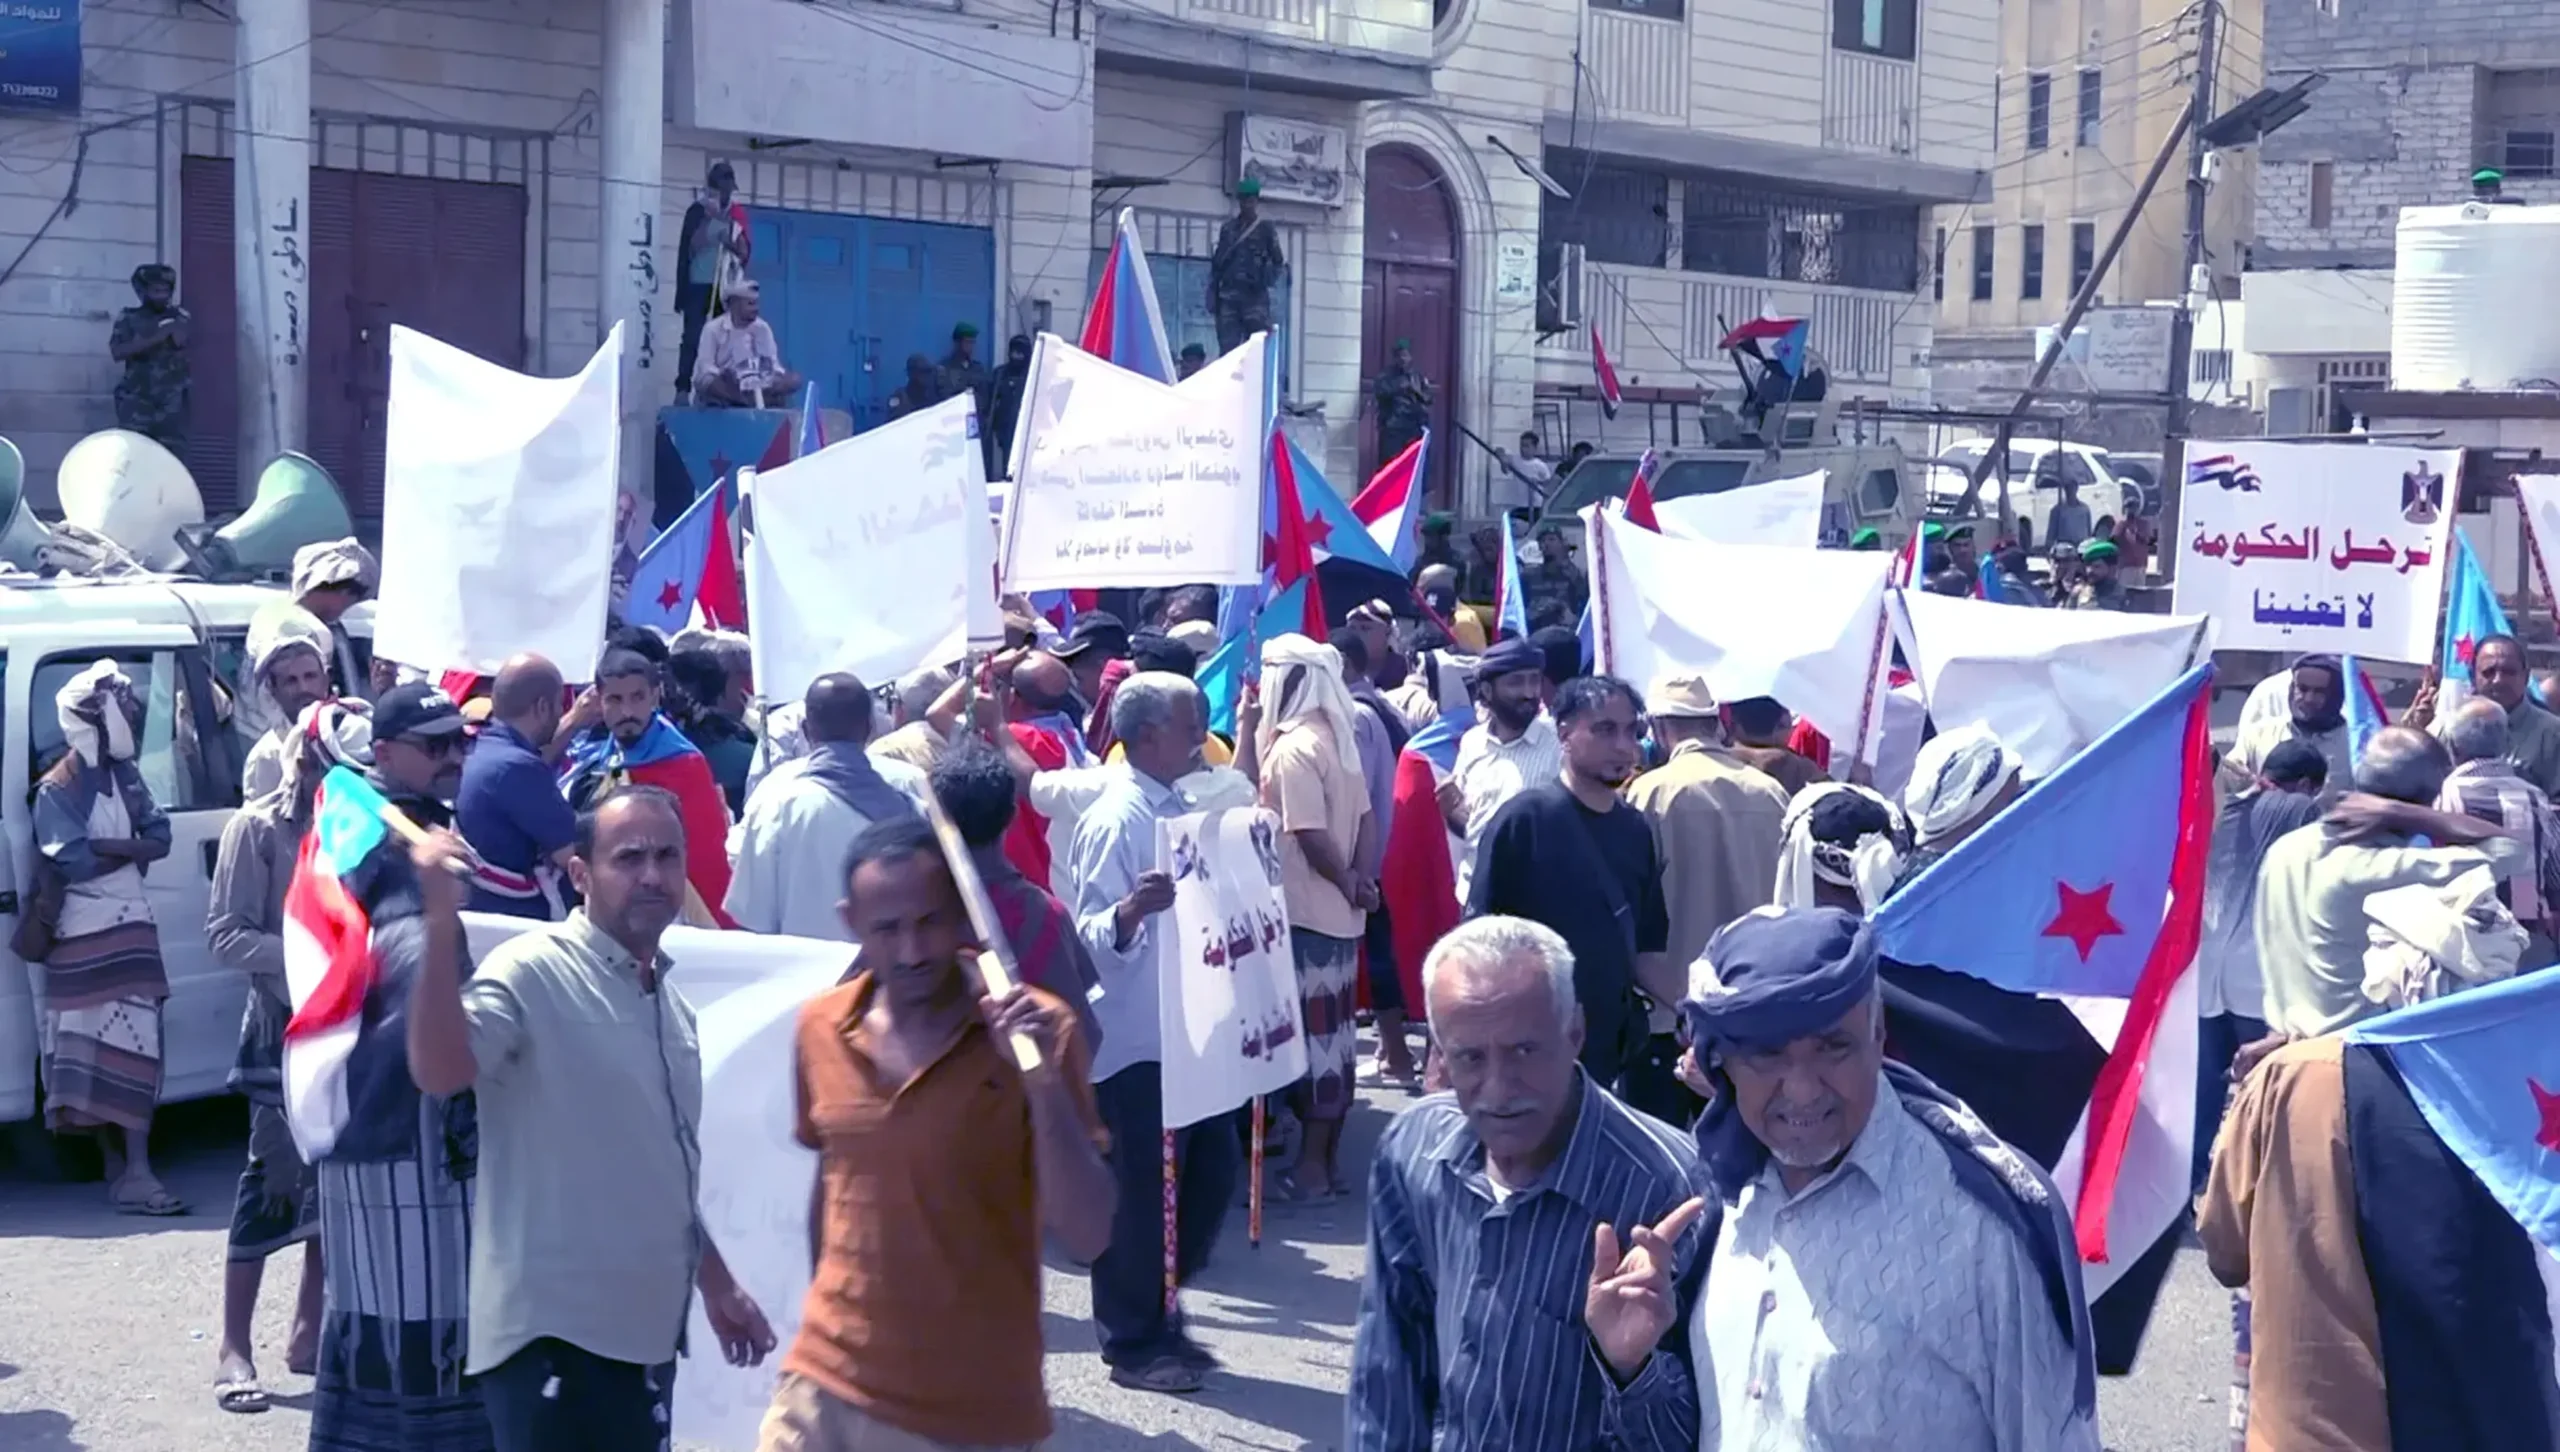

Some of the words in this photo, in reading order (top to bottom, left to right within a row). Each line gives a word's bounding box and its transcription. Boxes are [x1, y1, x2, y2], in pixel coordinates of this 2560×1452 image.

[2192, 521, 2319, 567] الحكومة
[2254, 588, 2346, 634] تعنينا
[2357, 592, 2374, 628] لا
